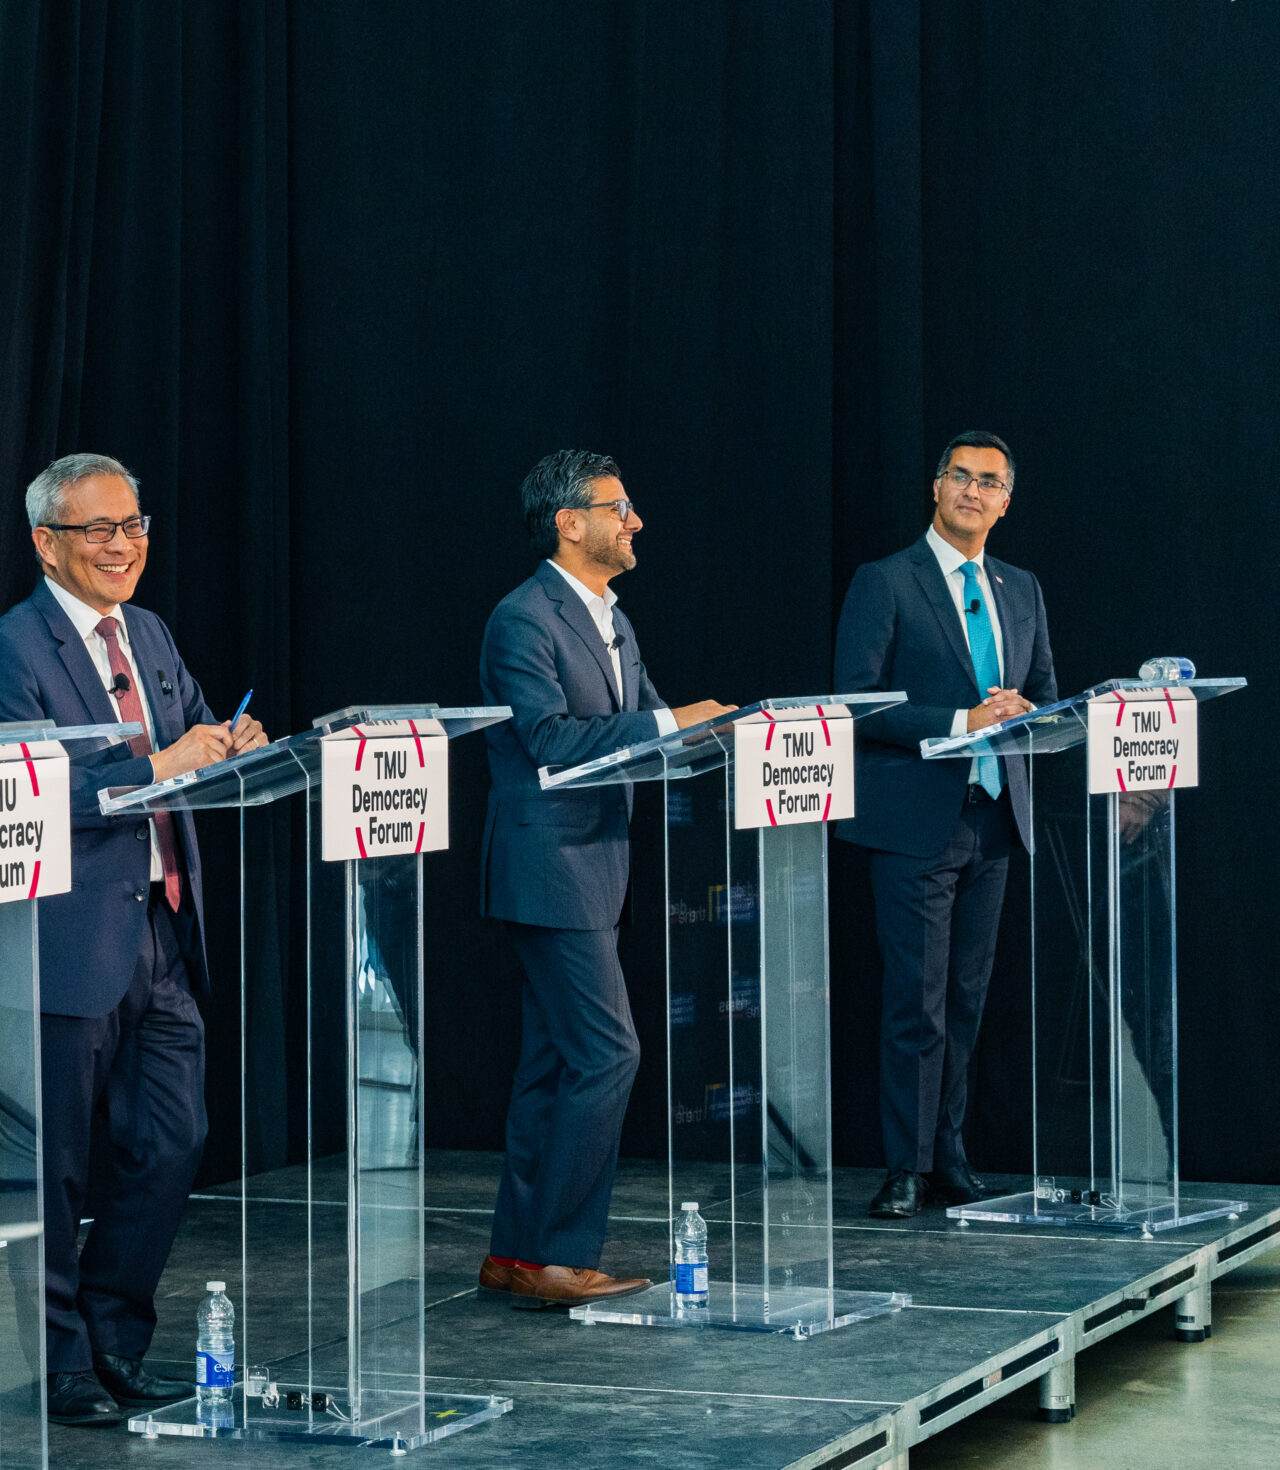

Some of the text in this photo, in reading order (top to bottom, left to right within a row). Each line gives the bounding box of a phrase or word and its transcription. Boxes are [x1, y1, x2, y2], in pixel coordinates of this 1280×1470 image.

[1132, 711, 1160, 733] TMU
[782, 732, 814, 758] TMU
[1114, 736, 1178, 759] Democracy
[374, 751, 406, 780] TMU
[762, 762, 834, 787] Democracy
[1128, 760, 1166, 782] Forum
[352, 784, 428, 815] Democracy
[778, 790, 820, 814] Forum
[369, 816, 412, 845] Forum
